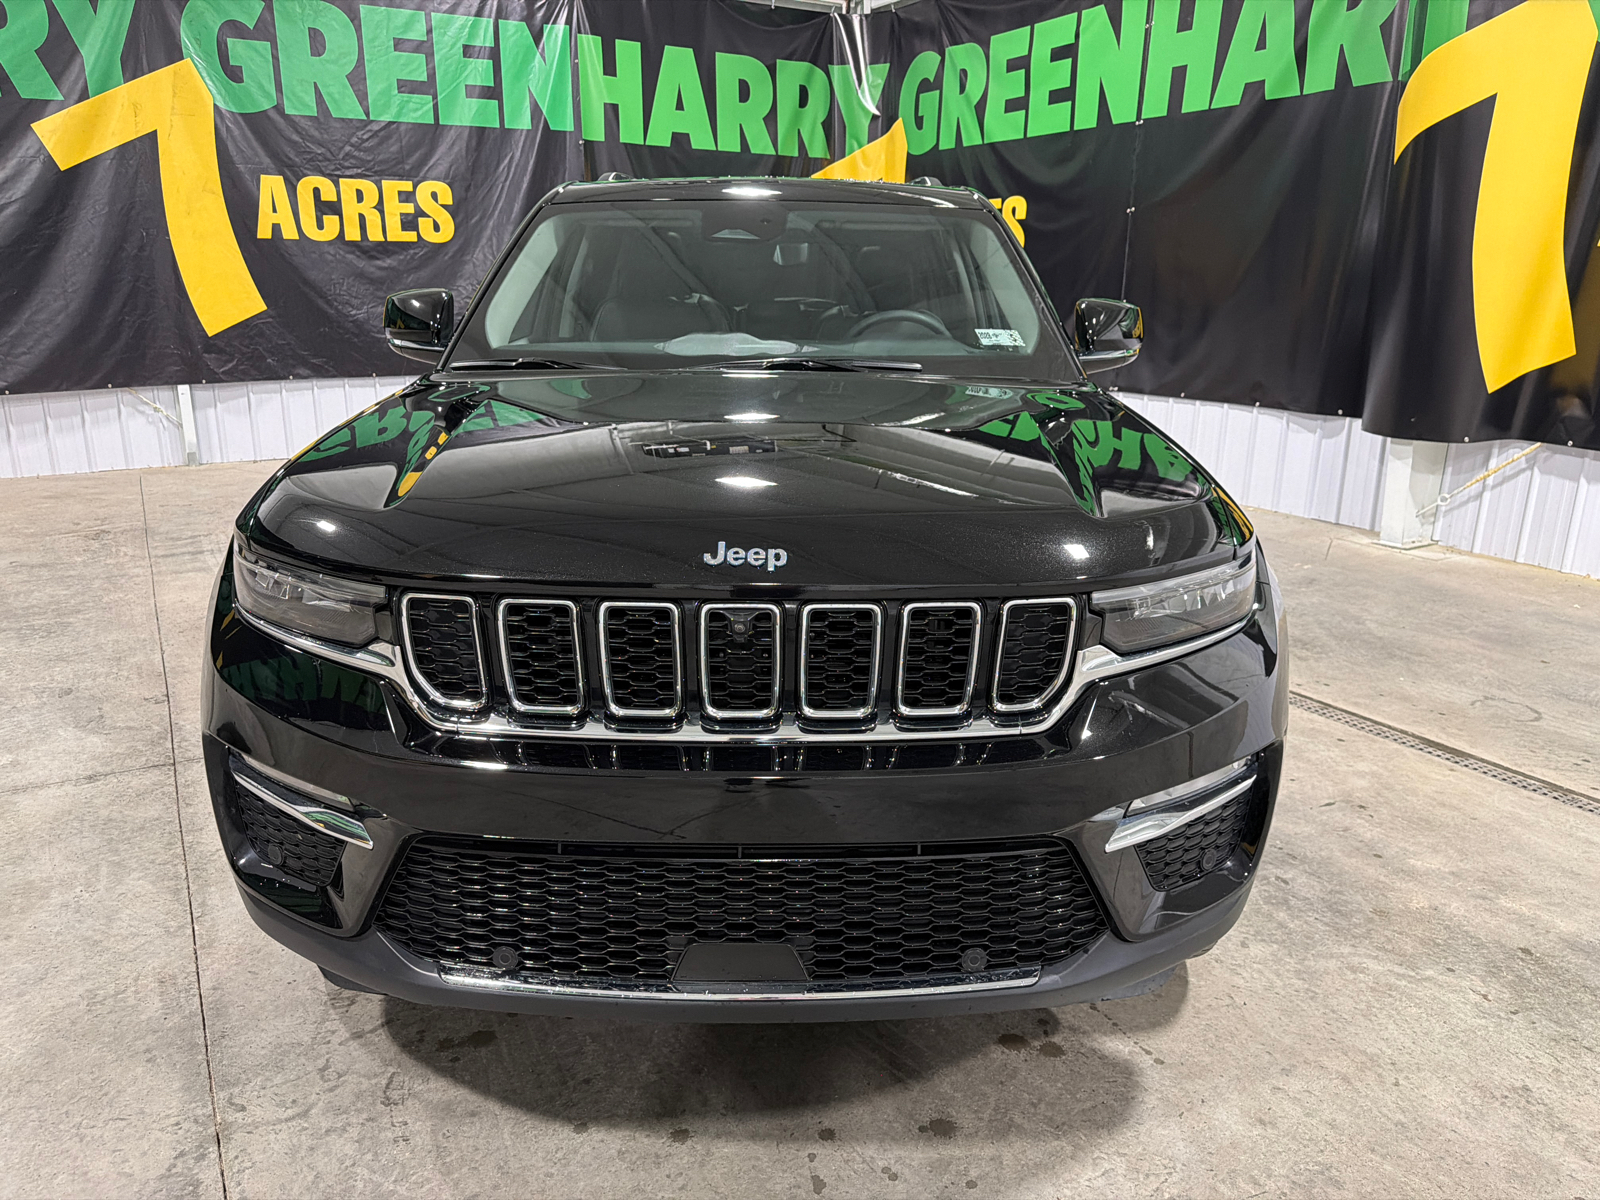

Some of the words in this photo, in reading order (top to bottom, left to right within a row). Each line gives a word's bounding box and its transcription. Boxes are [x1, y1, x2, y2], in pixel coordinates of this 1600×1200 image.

[181, 0, 574, 131] GREEN
[577, 34, 890, 158] HARRY
[900, 0, 1148, 156] GREEN
[30, 57, 268, 337] 7
[257, 174, 456, 244] ACRES
[1394, 0, 1598, 394] 7
[703, 541, 788, 572] Jeep
